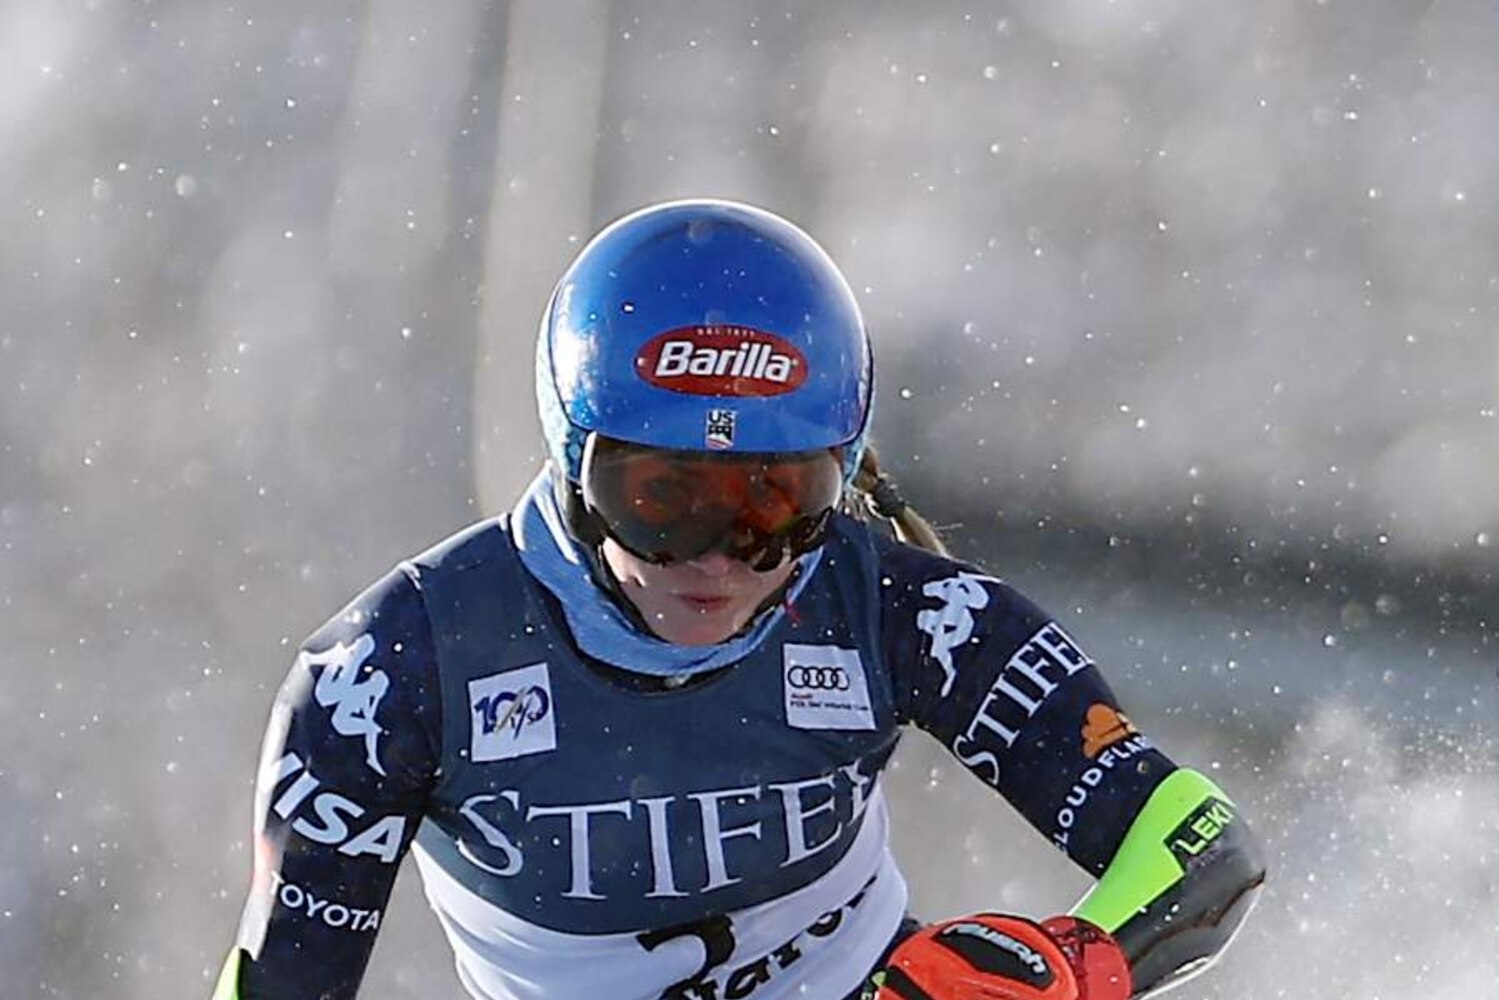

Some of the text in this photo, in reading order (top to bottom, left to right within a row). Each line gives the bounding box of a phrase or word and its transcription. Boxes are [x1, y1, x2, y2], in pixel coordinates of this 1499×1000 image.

[655, 341, 791, 382] Barilla
[708, 411, 733, 425] US
[1055, 734, 1148, 854] LOUDFLA
[1174, 801, 1235, 855] LEKI
[271, 870, 380, 931] TOYOTA
